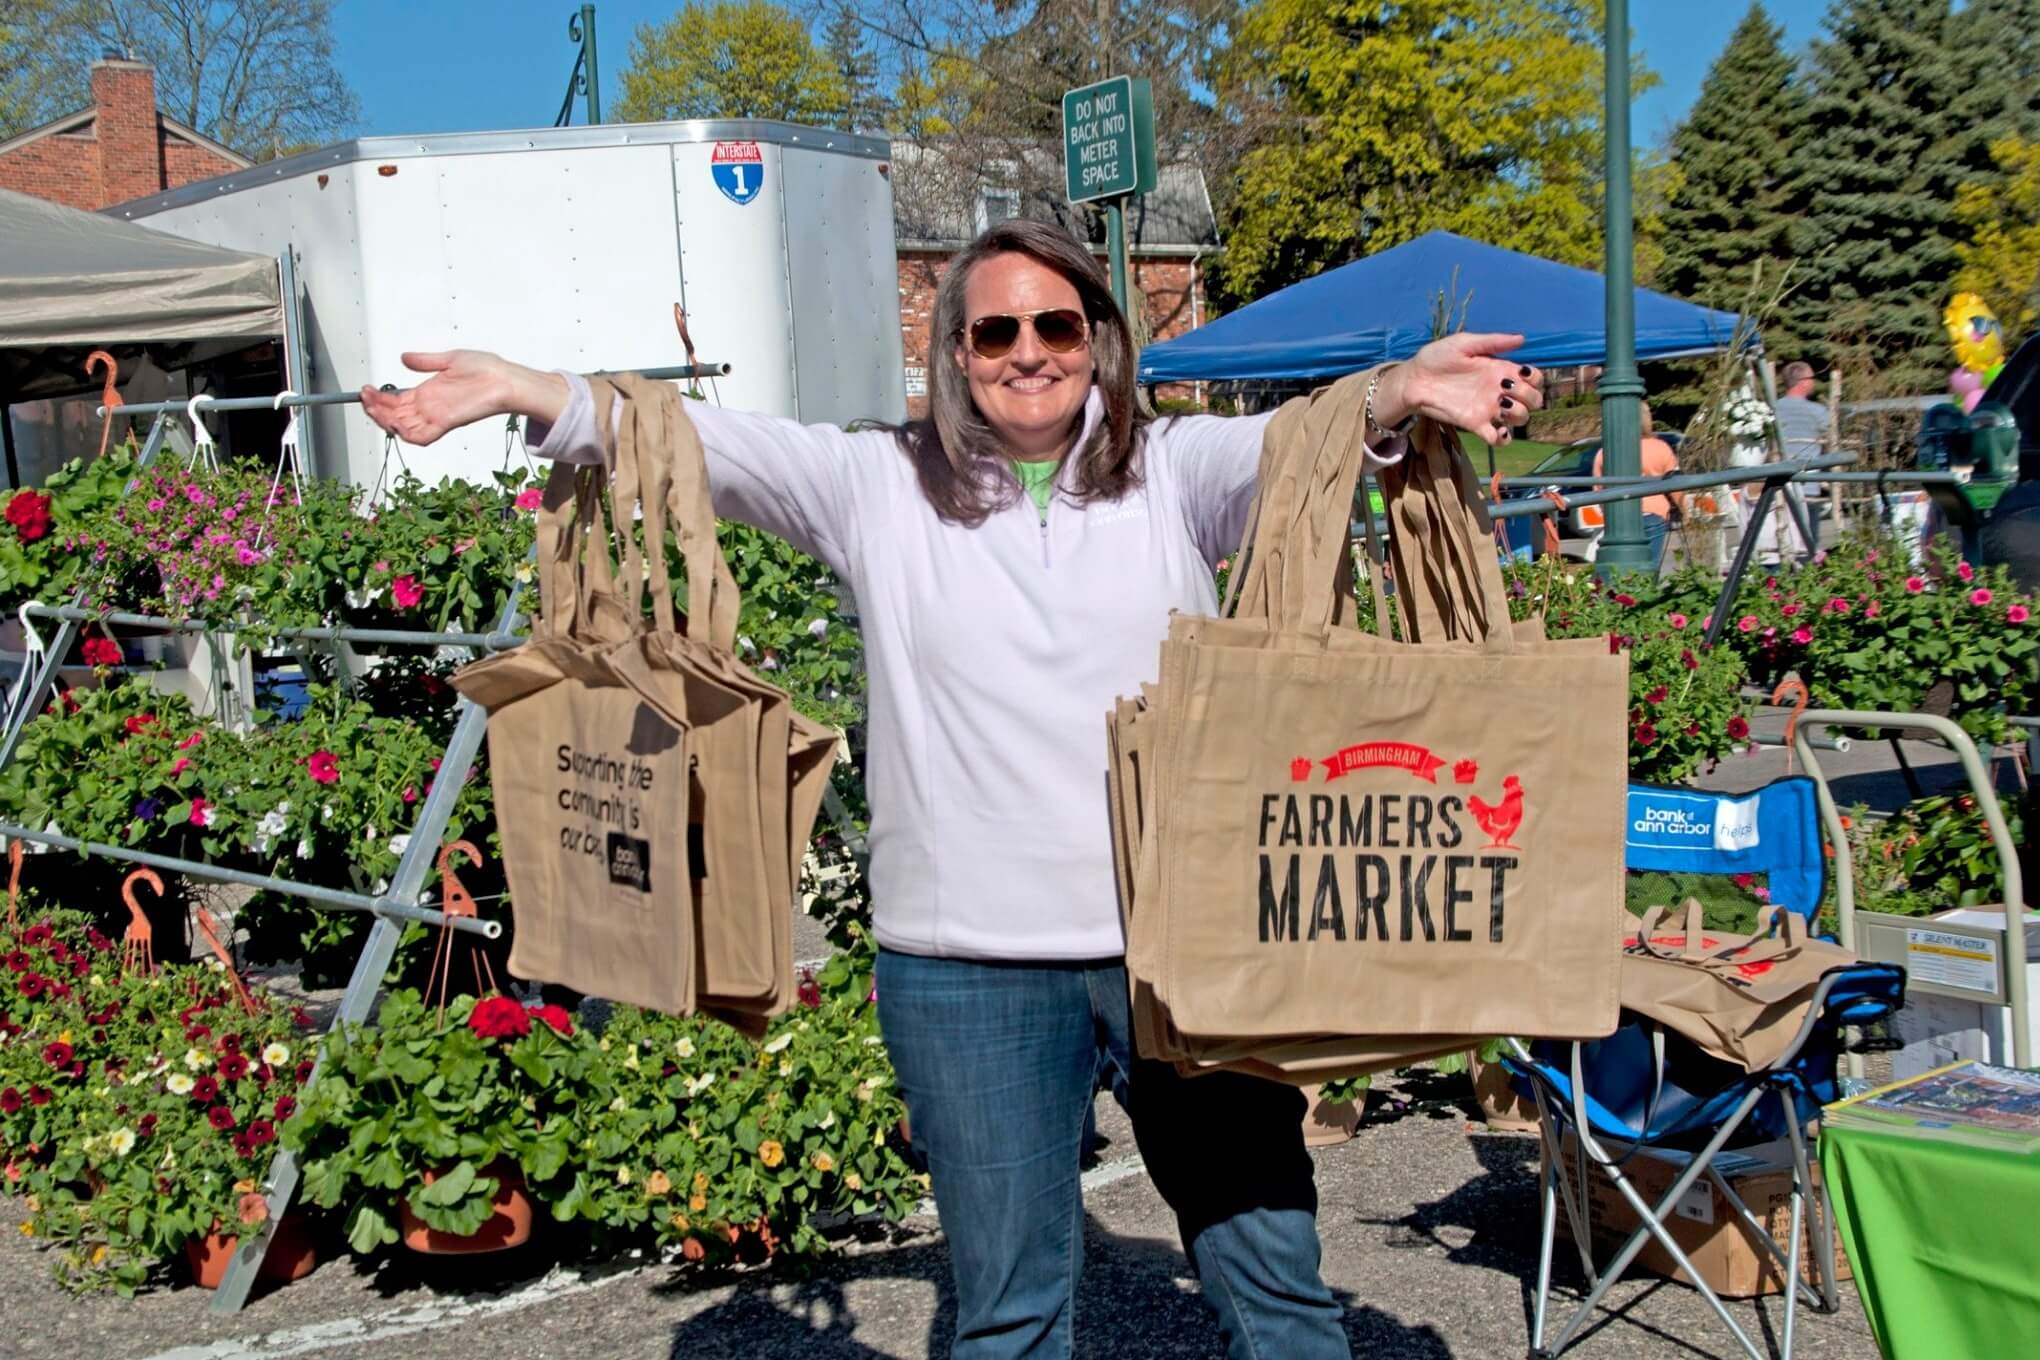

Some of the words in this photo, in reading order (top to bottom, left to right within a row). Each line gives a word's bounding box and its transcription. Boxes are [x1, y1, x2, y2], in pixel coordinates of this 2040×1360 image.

[1075, 100, 1092, 122] DO
[1095, 92, 1118, 116] NOT
[1071, 121, 1099, 145] BACK
[1102, 114, 1126, 137] INTO
[716, 145, 758, 158] INTERSTATE
[1080, 139, 1118, 165] METER
[732, 165, 749, 195] 1
[1082, 161, 1120, 187] SPACE
[1344, 747, 1421, 768] BIRMINGHAM
[628, 757, 654, 790] the
[1258, 794, 1463, 848] FARMERS
[1634, 820, 1665, 833] ann
[1667, 821, 1711, 835] arbor
[1645, 806, 1686, 823] bank
[1258, 854, 1519, 943] MARKET
